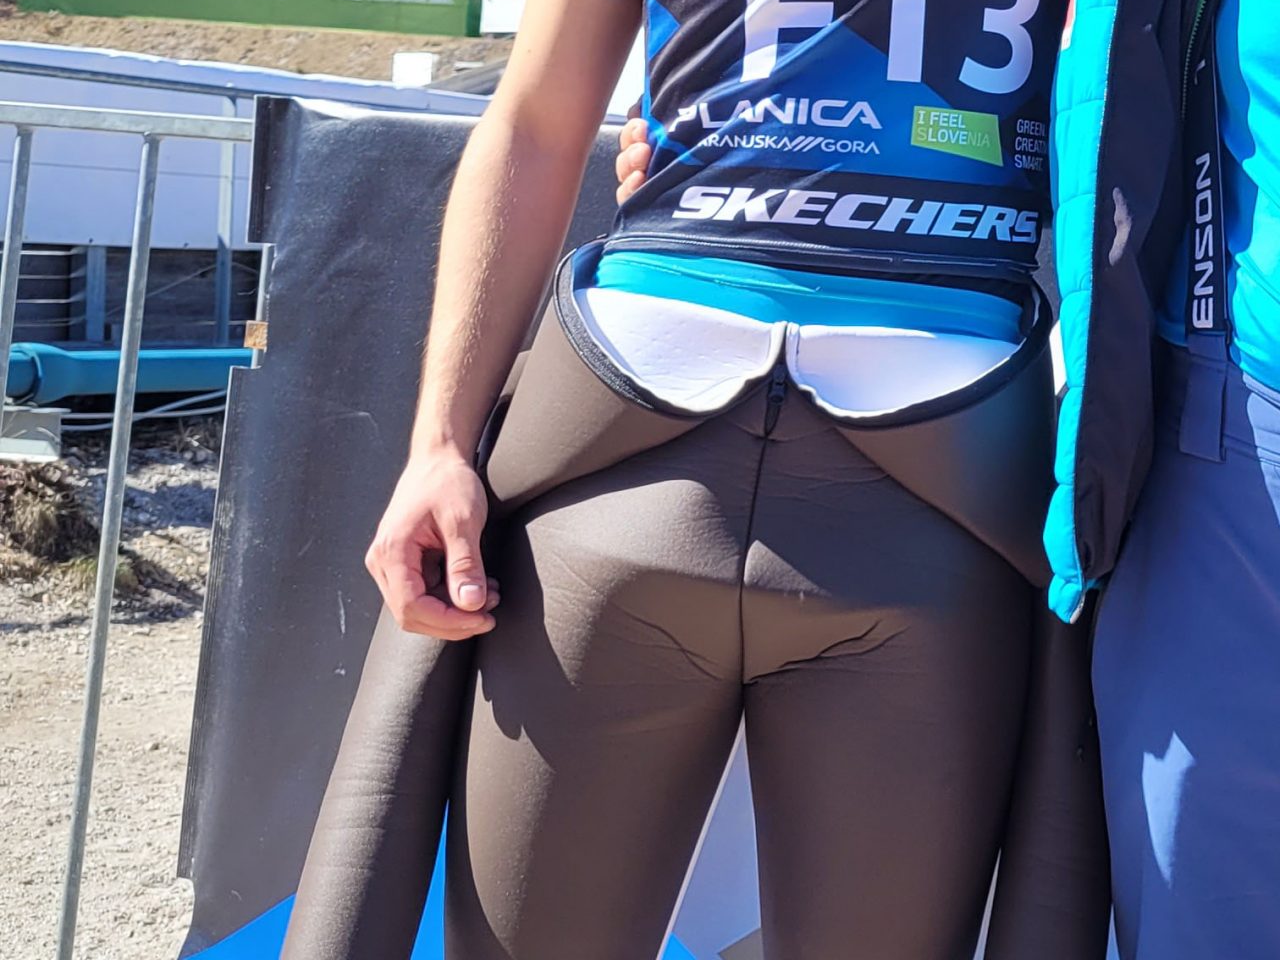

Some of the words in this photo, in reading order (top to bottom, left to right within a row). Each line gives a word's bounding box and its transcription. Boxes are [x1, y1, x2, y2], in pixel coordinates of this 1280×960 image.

[917, 110, 926, 124] I
[929, 111, 966, 129] FEEL
[821, 139, 880, 155] GORA
[917, 126, 992, 148] SLOVENIA
[671, 185, 1040, 244] SKECHERS
[1192, 152, 1214, 329] ENSON
